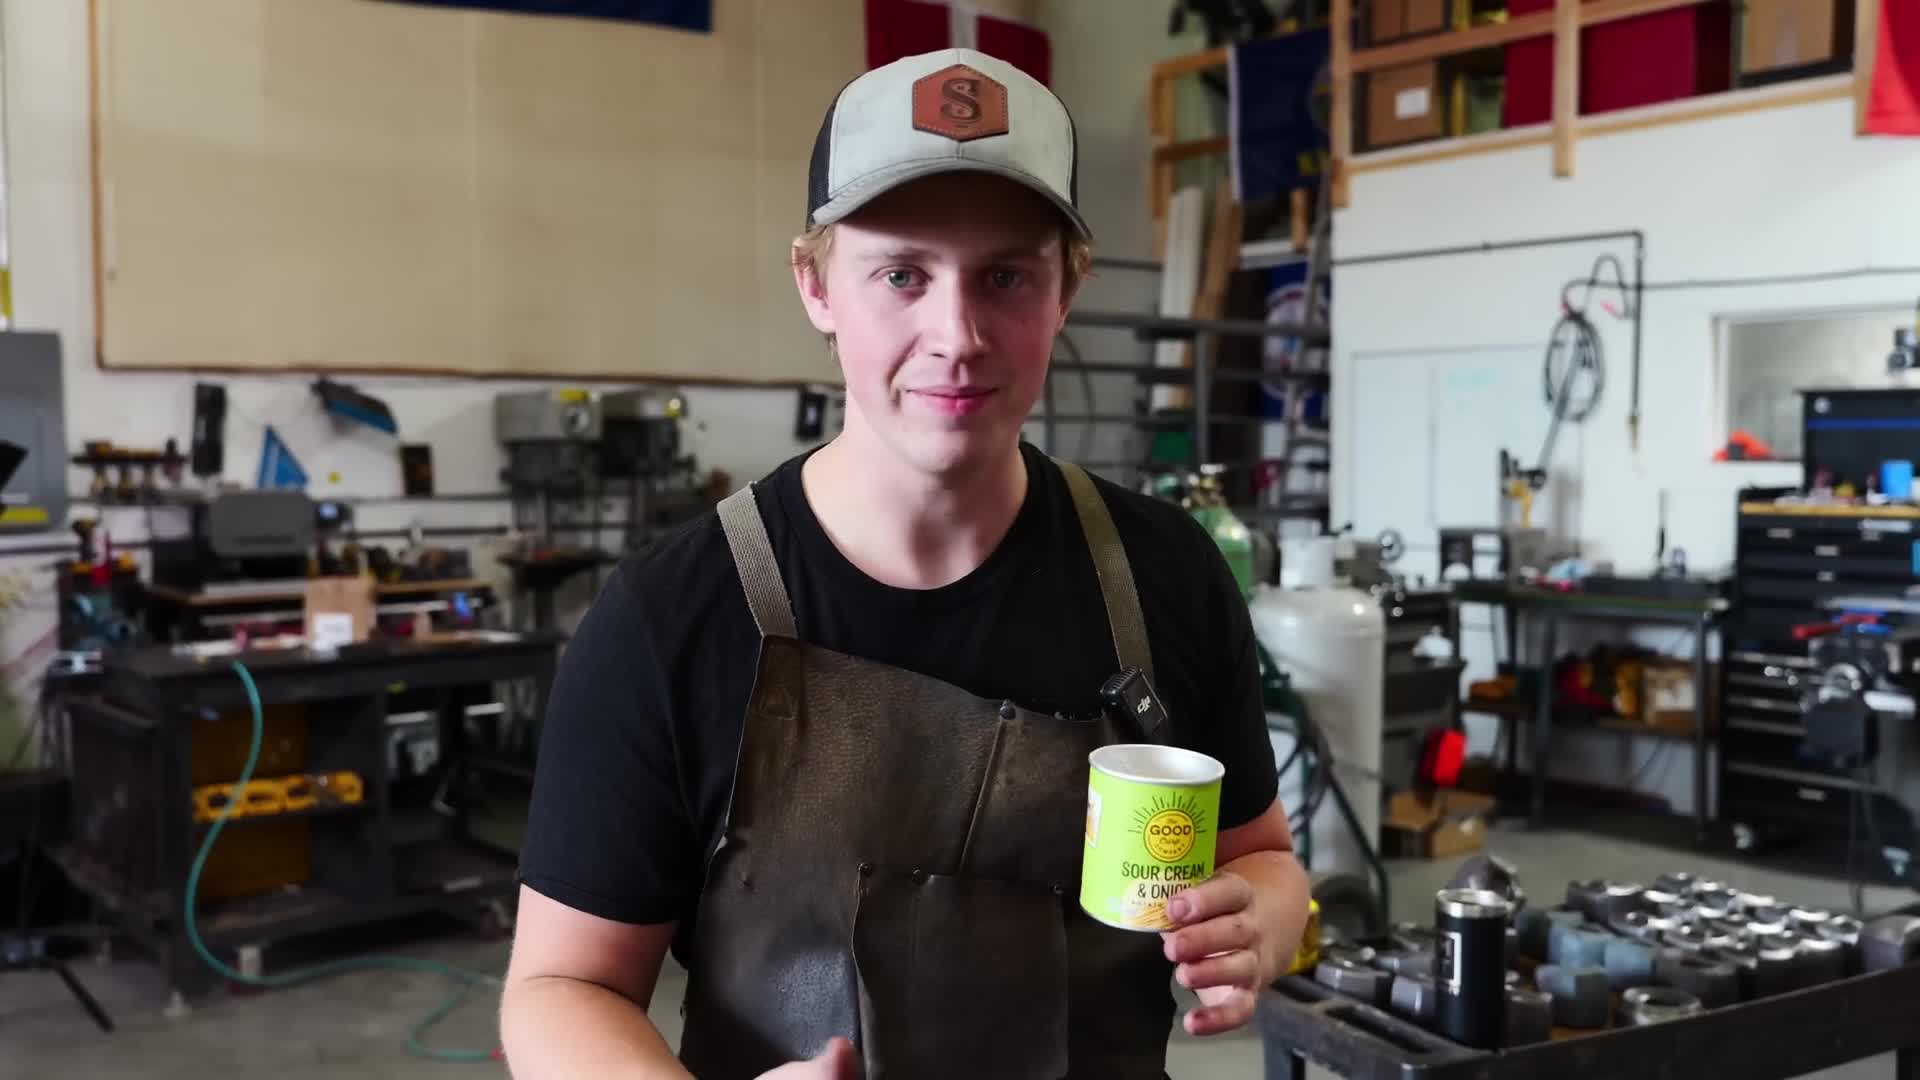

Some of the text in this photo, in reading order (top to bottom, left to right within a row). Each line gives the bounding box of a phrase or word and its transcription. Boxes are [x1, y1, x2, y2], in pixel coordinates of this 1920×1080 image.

[941, 78, 982, 121] S
[1137, 696, 1151, 713] dji
[1150, 824, 1192, 836] GOOD
[1121, 861, 1205, 881] SOUR CREAM
[1137, 883, 1147, 898] &
